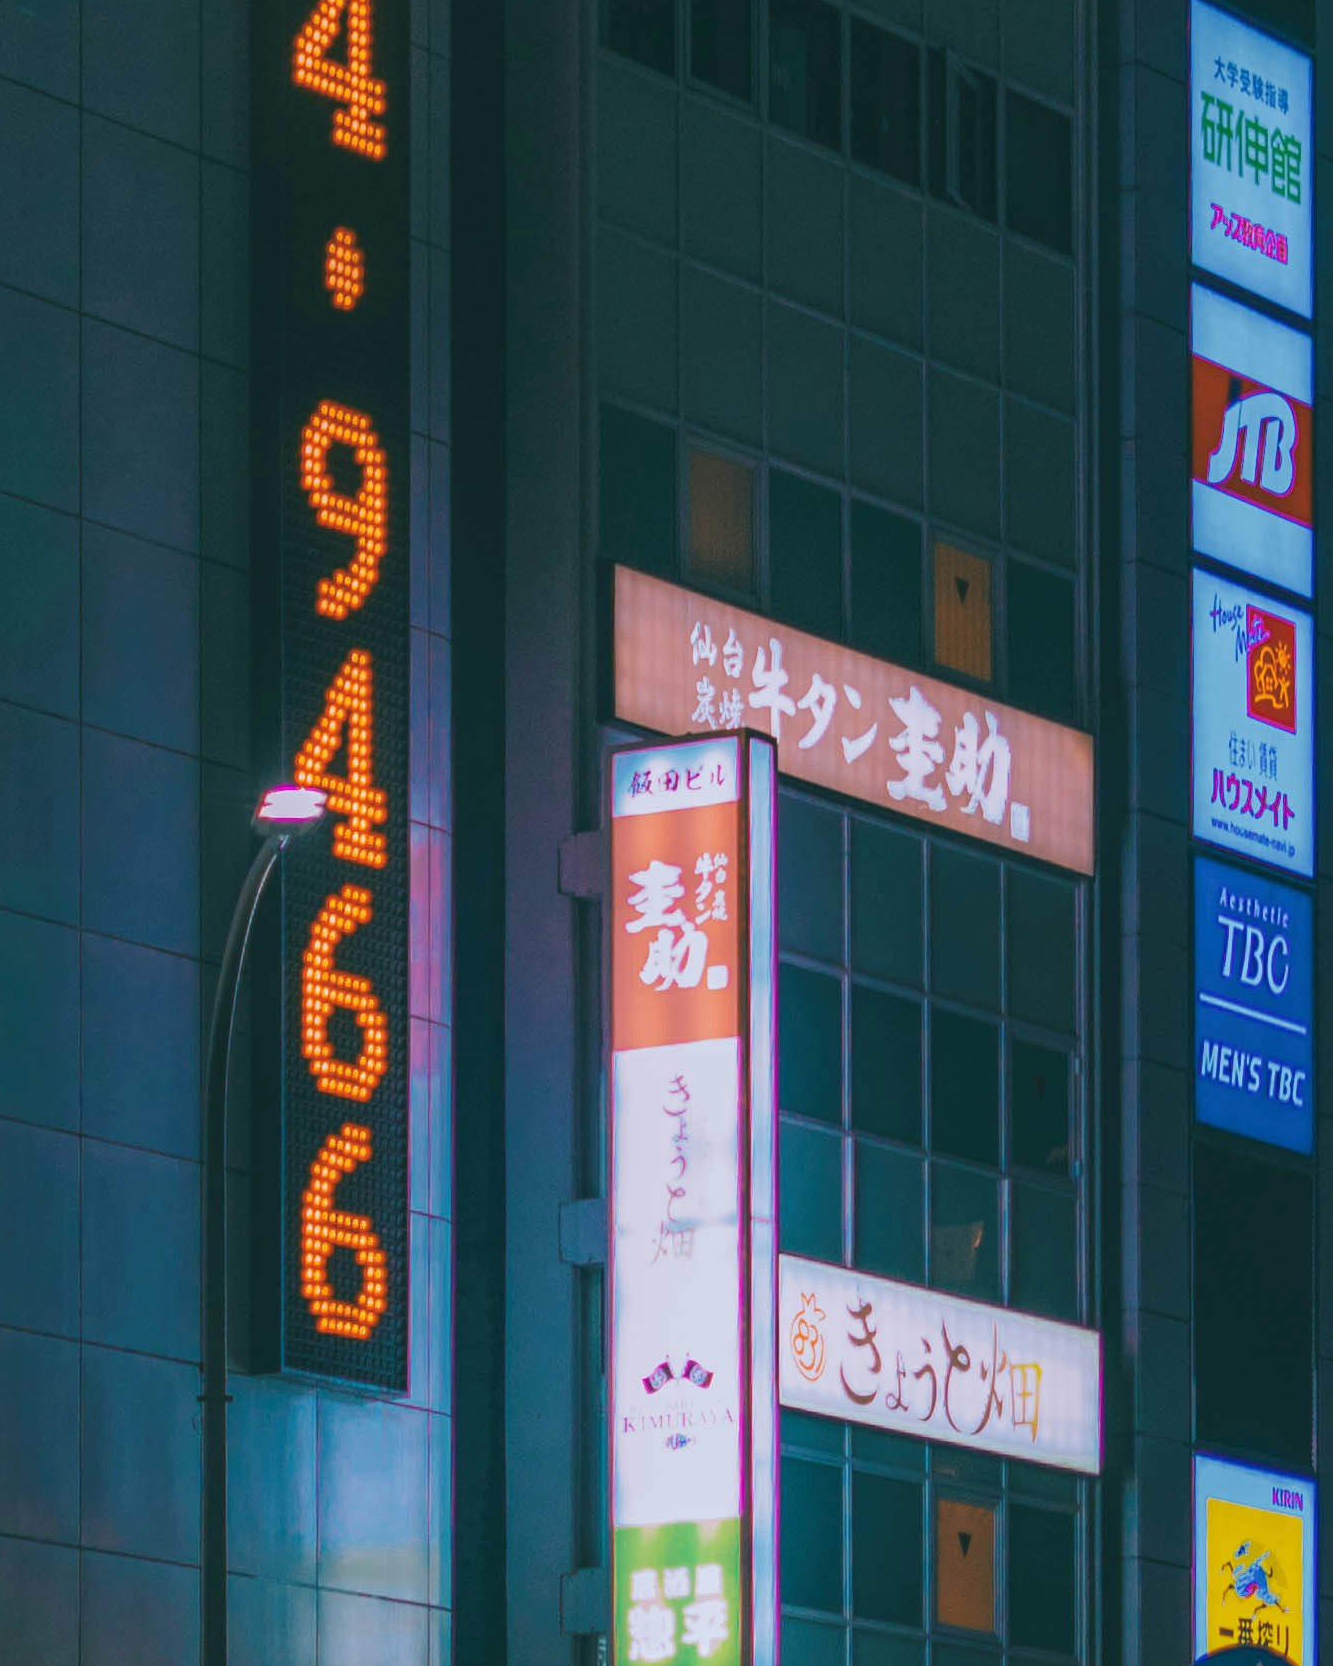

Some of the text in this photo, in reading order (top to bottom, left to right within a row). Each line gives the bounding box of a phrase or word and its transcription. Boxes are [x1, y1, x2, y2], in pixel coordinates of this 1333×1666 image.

[1200, 89, 1302, 205] 研伸館
[1207, 391, 1297, 498] JTB
[1209, 592, 1244, 633] House
[690, 620, 744, 678] 仙台
[691, 675, 746, 730] 炭焼
[748, 637, 878, 765] 牛タン
[627, 763, 726, 799] 飯田ビル
[1210, 767, 1295, 831] ハウスメイト
[1219, 886, 1289, 929] Aesthetic
[1217, 914, 1289, 995] TBC
[1200, 1039, 1306, 1107] MEN'S TBC
[837, 1298, 1043, 1445] きょうと畑
[622, 1407, 734, 1434] KIMURAYA
[1271, 1486, 1304, 1512] KIRIN
